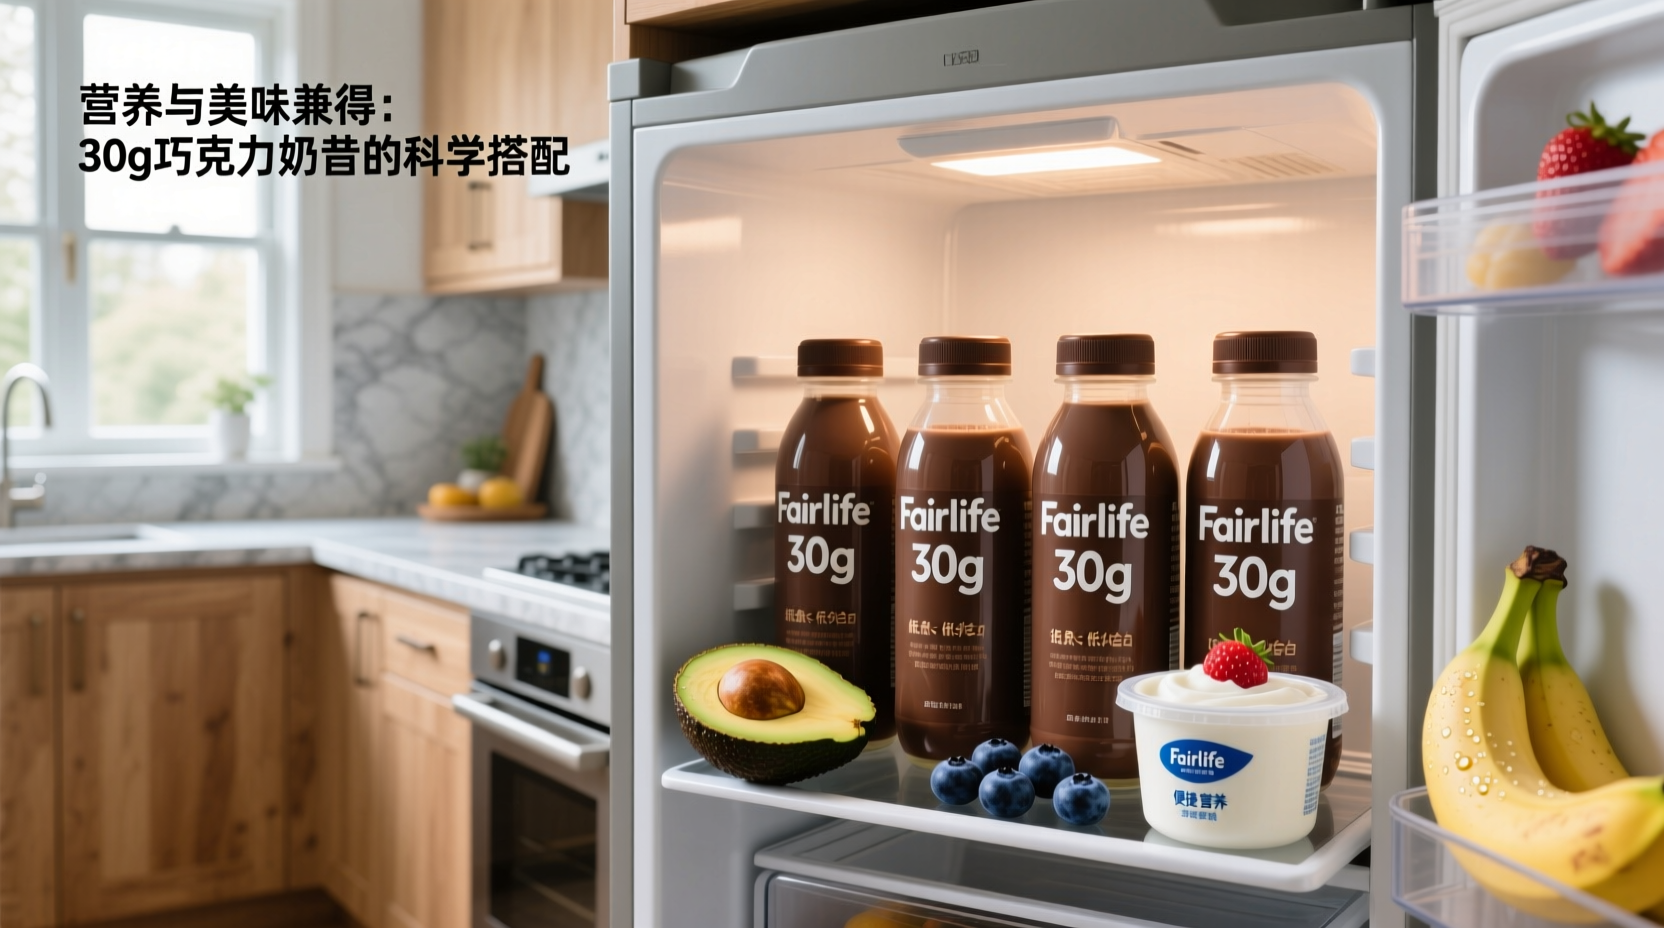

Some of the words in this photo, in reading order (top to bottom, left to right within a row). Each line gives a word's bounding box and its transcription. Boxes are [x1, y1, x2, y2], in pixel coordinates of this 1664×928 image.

[778, 491, 870, 526] Fairlife
[900, 496, 1001, 533] Fairlife
[1040, 500, 1150, 540] Fairlife
[1199, 504, 1314, 545] Fairlife
[787, 534, 855, 585] 30g
[911, 543, 984, 596] 30g
[1052, 549, 1133, 605] 30g
[1212, 554, 1296, 611] 30g
[1170, 747, 1225, 769] Fairlife
